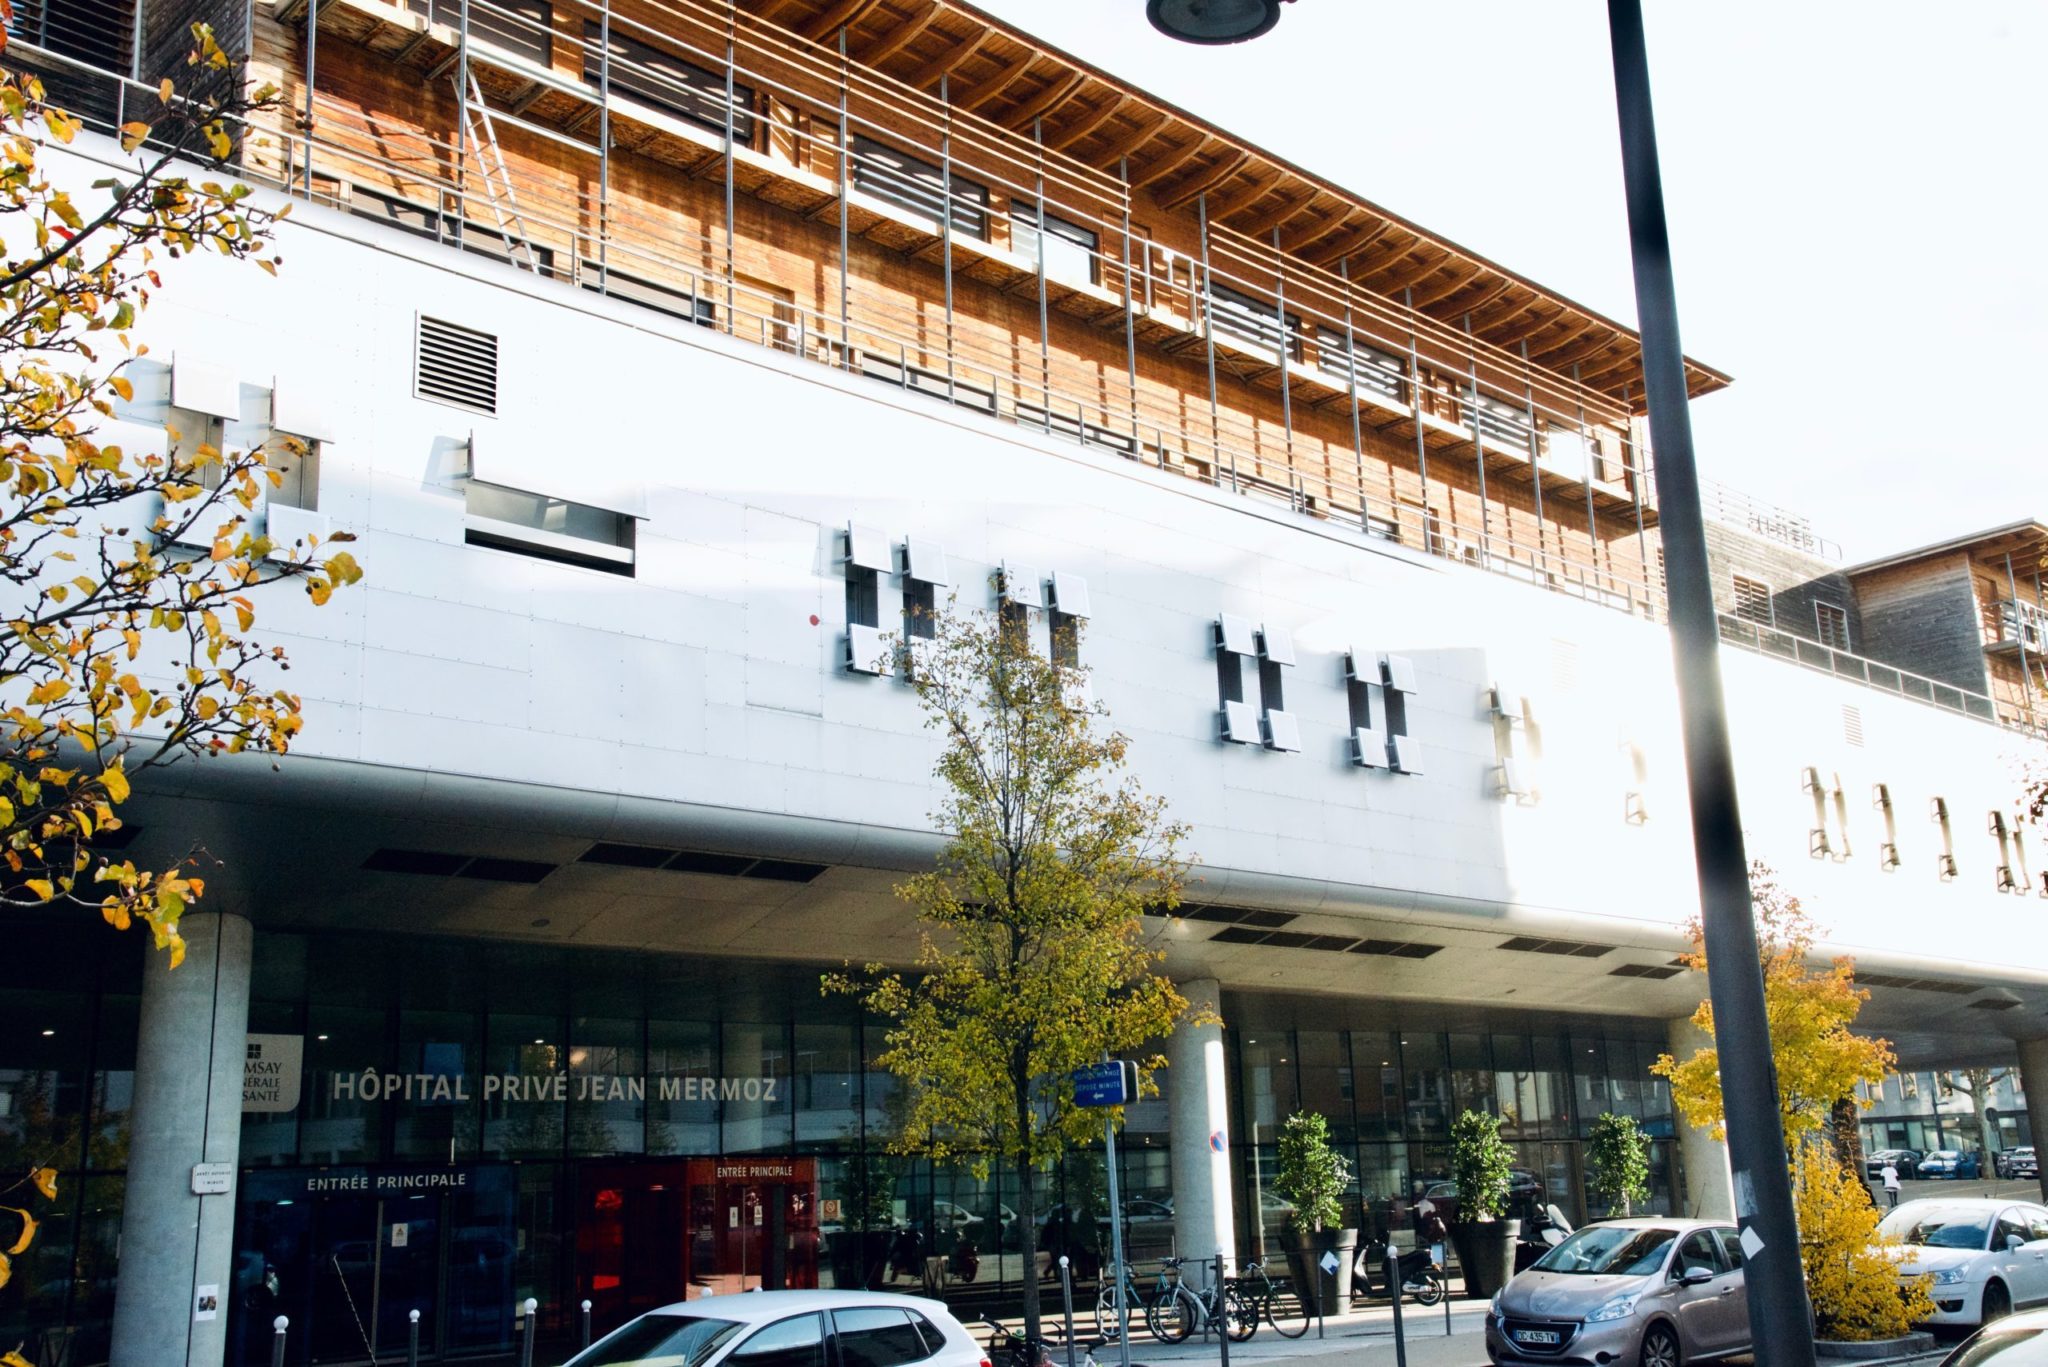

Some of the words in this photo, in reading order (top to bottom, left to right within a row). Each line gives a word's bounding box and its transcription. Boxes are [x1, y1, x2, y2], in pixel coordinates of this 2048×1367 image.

[244, 1062, 282, 1074] MSAY
[243, 1075, 280, 1088] ÉRALE
[334, 1067, 470, 1101] HÔPITAL
[484, 1070, 567, 1101] PRIVÉ
[577, 1076, 645, 1101] JEAN
[659, 1077, 777, 1101] MERMOZ
[242, 1089, 280, 1102] SANTÉ
[717, 1165, 747, 1178] ENTRÉE
[750, 1166, 793, 1177] PRINCIPALE
[307, 1174, 369, 1191] ENTRÉE
[377, 1173, 466, 1189] PRINCIPALE
